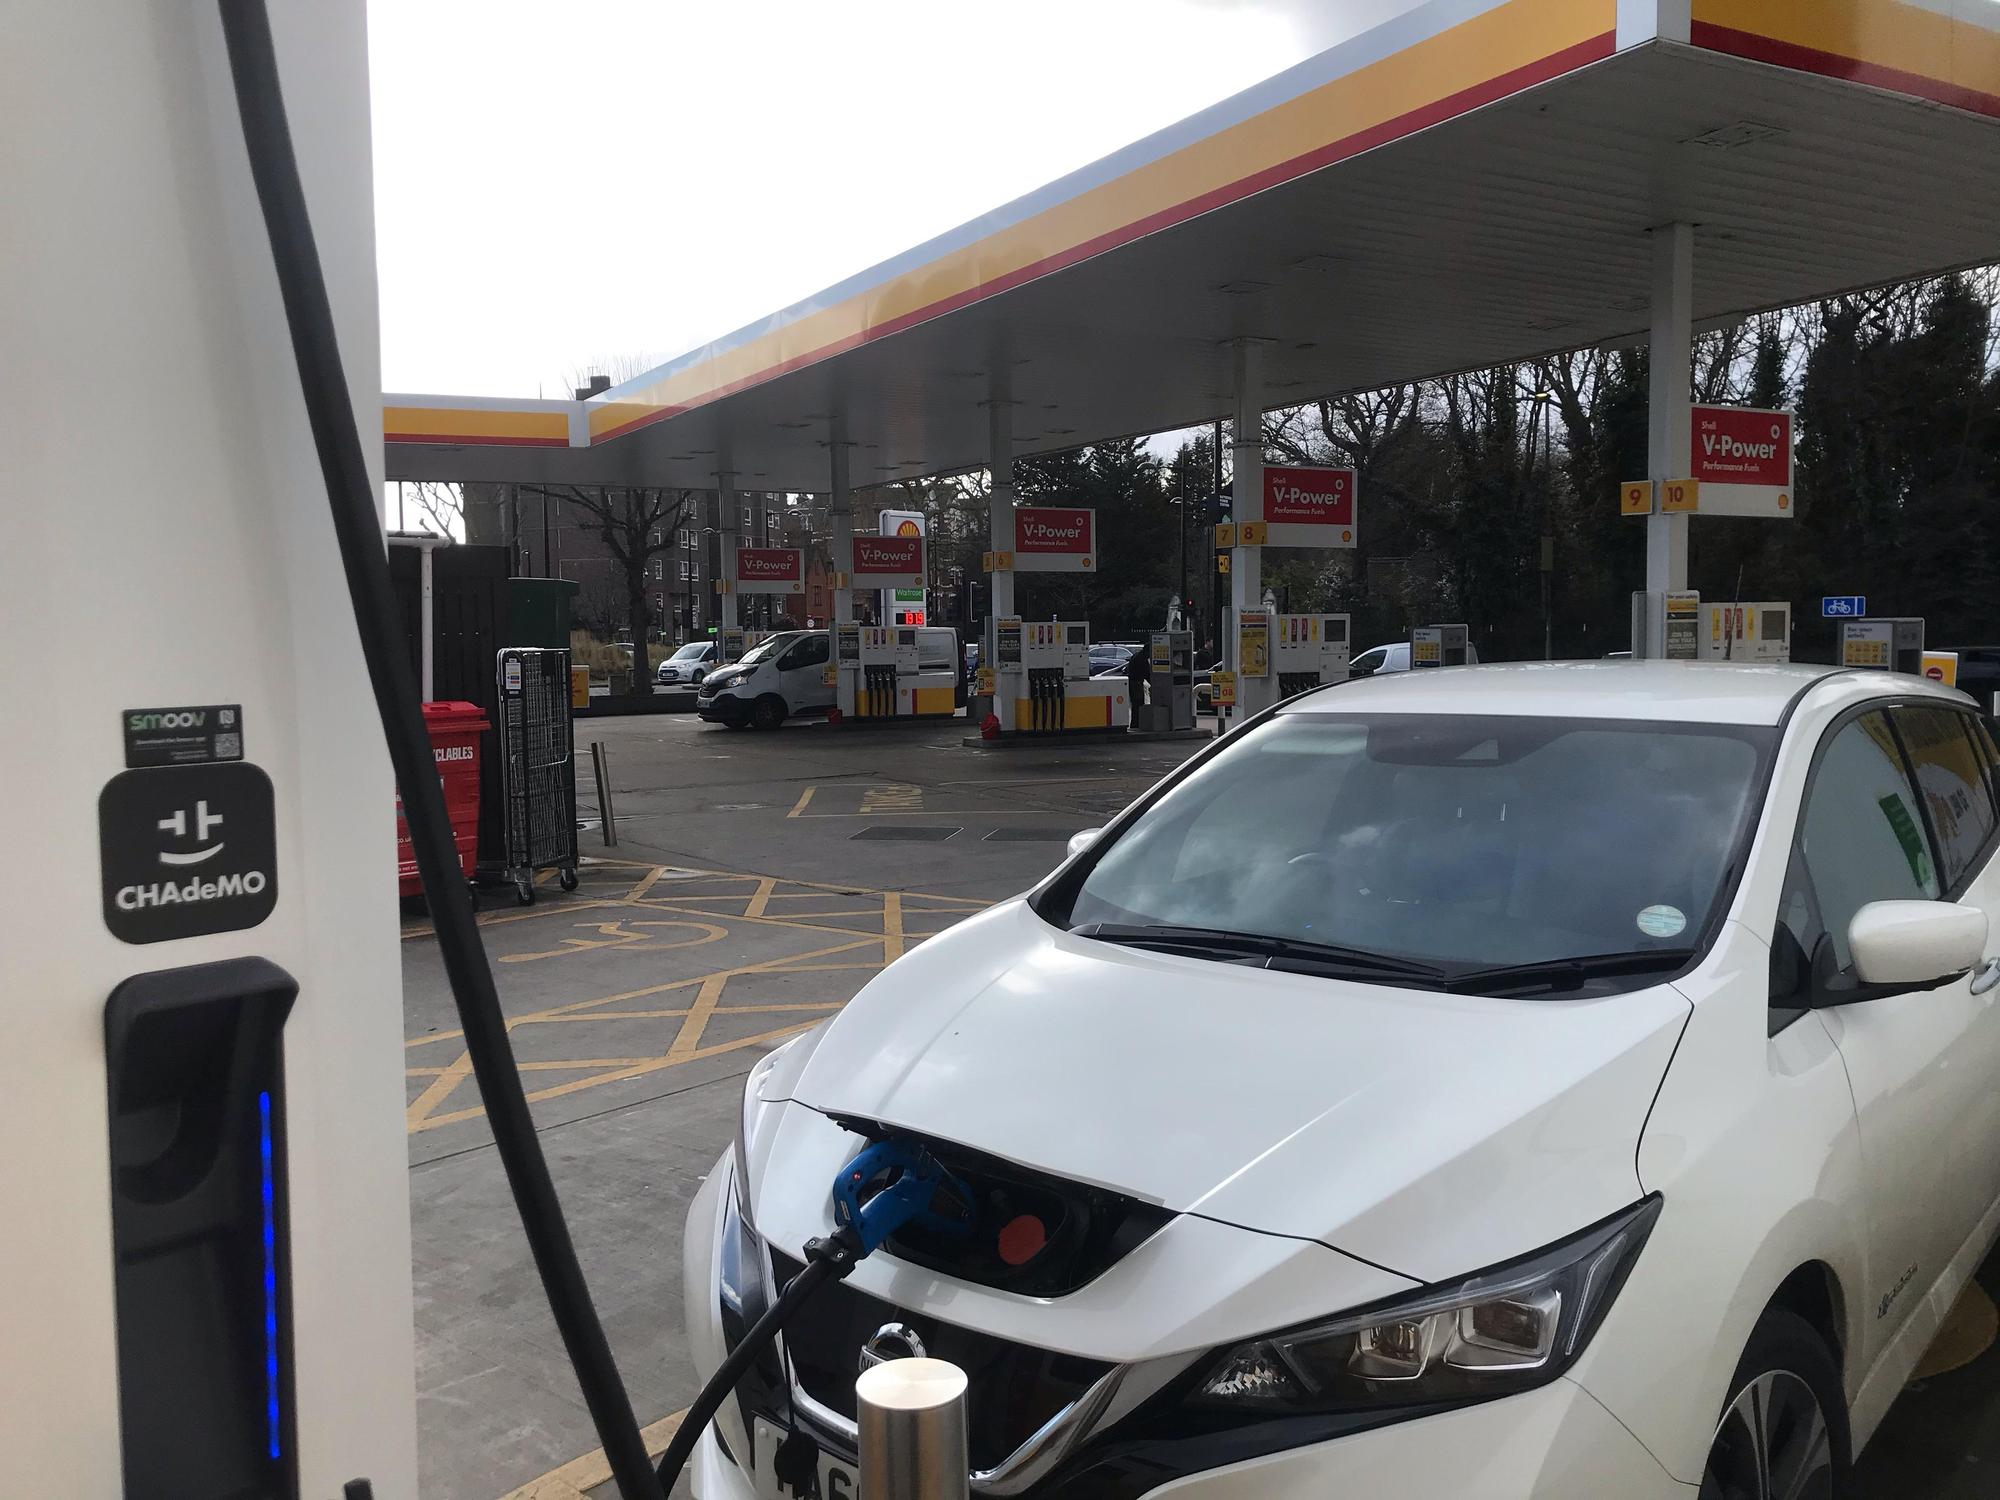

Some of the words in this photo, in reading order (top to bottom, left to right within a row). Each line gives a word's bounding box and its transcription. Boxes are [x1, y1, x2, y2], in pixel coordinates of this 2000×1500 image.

[1701, 420, 1717, 430] Shell
[1702, 433, 1776, 459] V-Power
[1702, 460, 1743, 472] Performance
[1744, 463, 1760, 472] Fuels
[1273, 486, 1341, 505] V-Power
[1630, 488, 1642, 506] 9
[1667, 486, 1684, 503] 10
[1273, 506, 1310, 515] Performance
[1311, 507, 1326, 515] Fuels
[1023, 524, 1081, 538] V-Power
[1221, 529, 1229, 541] 7
[1244, 526, 1254, 540] 8
[860, 549, 913, 561] V-Power
[744, 559, 792, 570] V-Power
[896, 588, 923, 597] Waitrose
[432, 746, 474, 762] CLABLES
[115, 869, 266, 911] CHAdeMO
